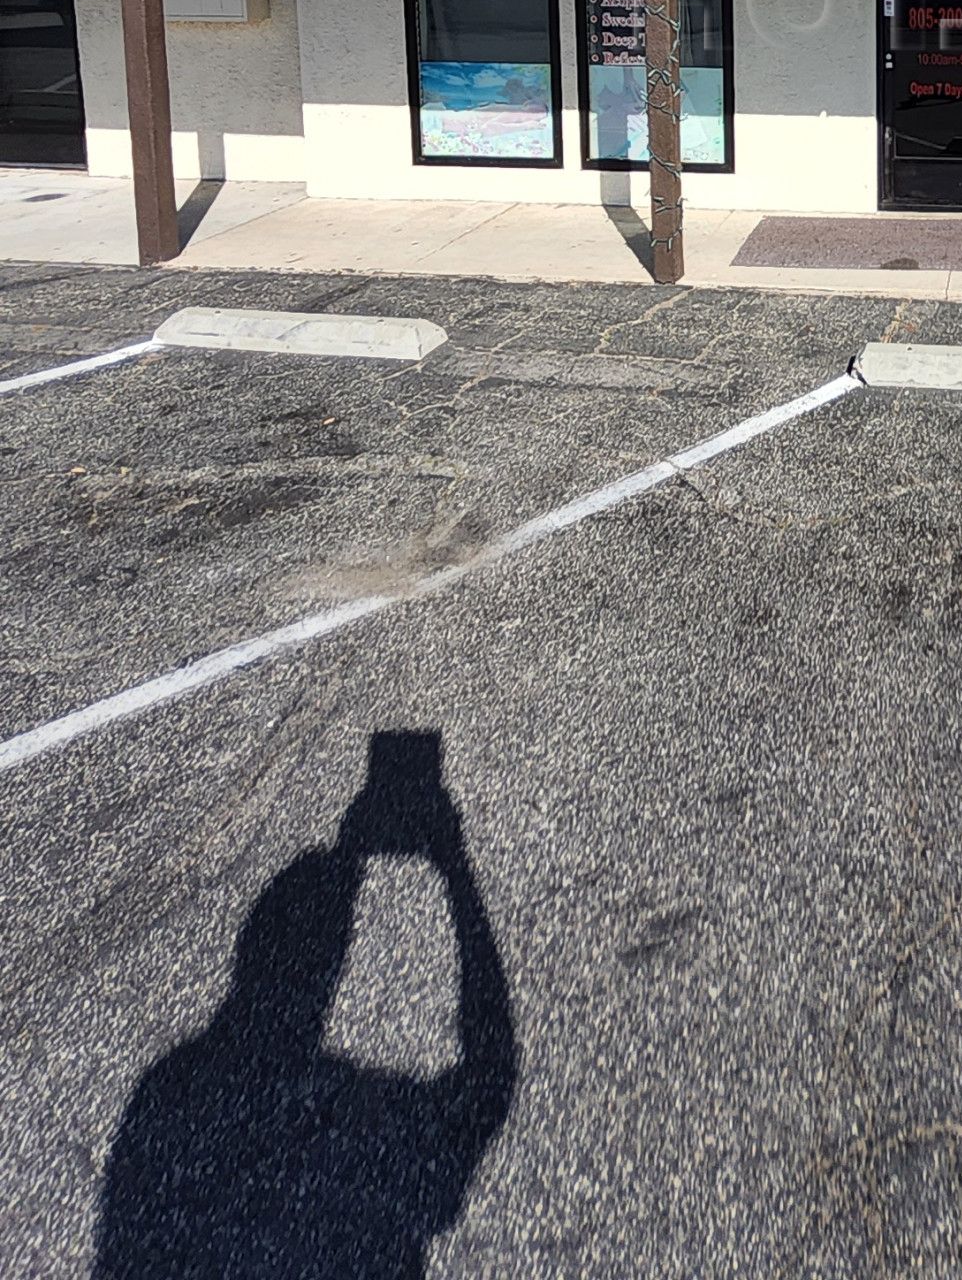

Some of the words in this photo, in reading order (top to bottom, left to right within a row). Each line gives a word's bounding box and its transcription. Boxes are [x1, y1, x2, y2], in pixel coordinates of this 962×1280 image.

[602, 32, 637, 49] Deep
[910, 82, 934, 98] Open
[935, 83, 943, 96] 7
